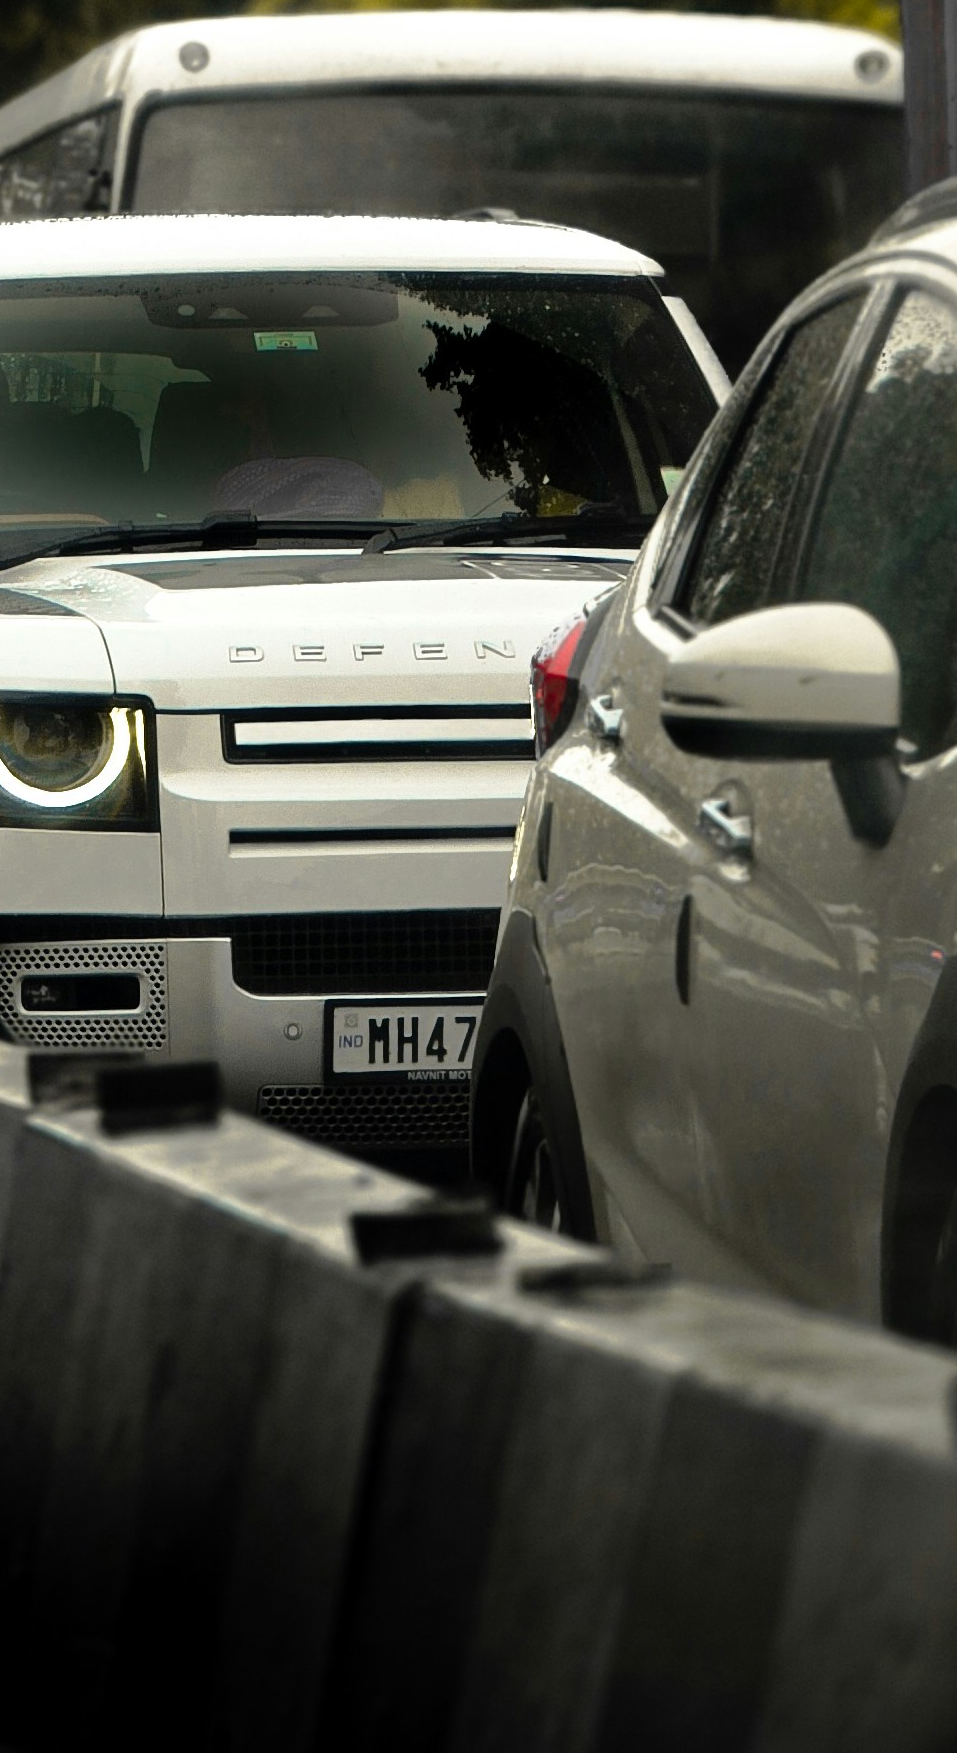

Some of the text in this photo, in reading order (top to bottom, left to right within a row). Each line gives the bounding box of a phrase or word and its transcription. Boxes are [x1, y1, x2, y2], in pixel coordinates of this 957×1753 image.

[228, 640, 515, 663] DEFEN
[338, 1034, 364, 1048] IND
[368, 1016, 477, 1064] MH47
[407, 1070, 446, 1081] NAVNIT
